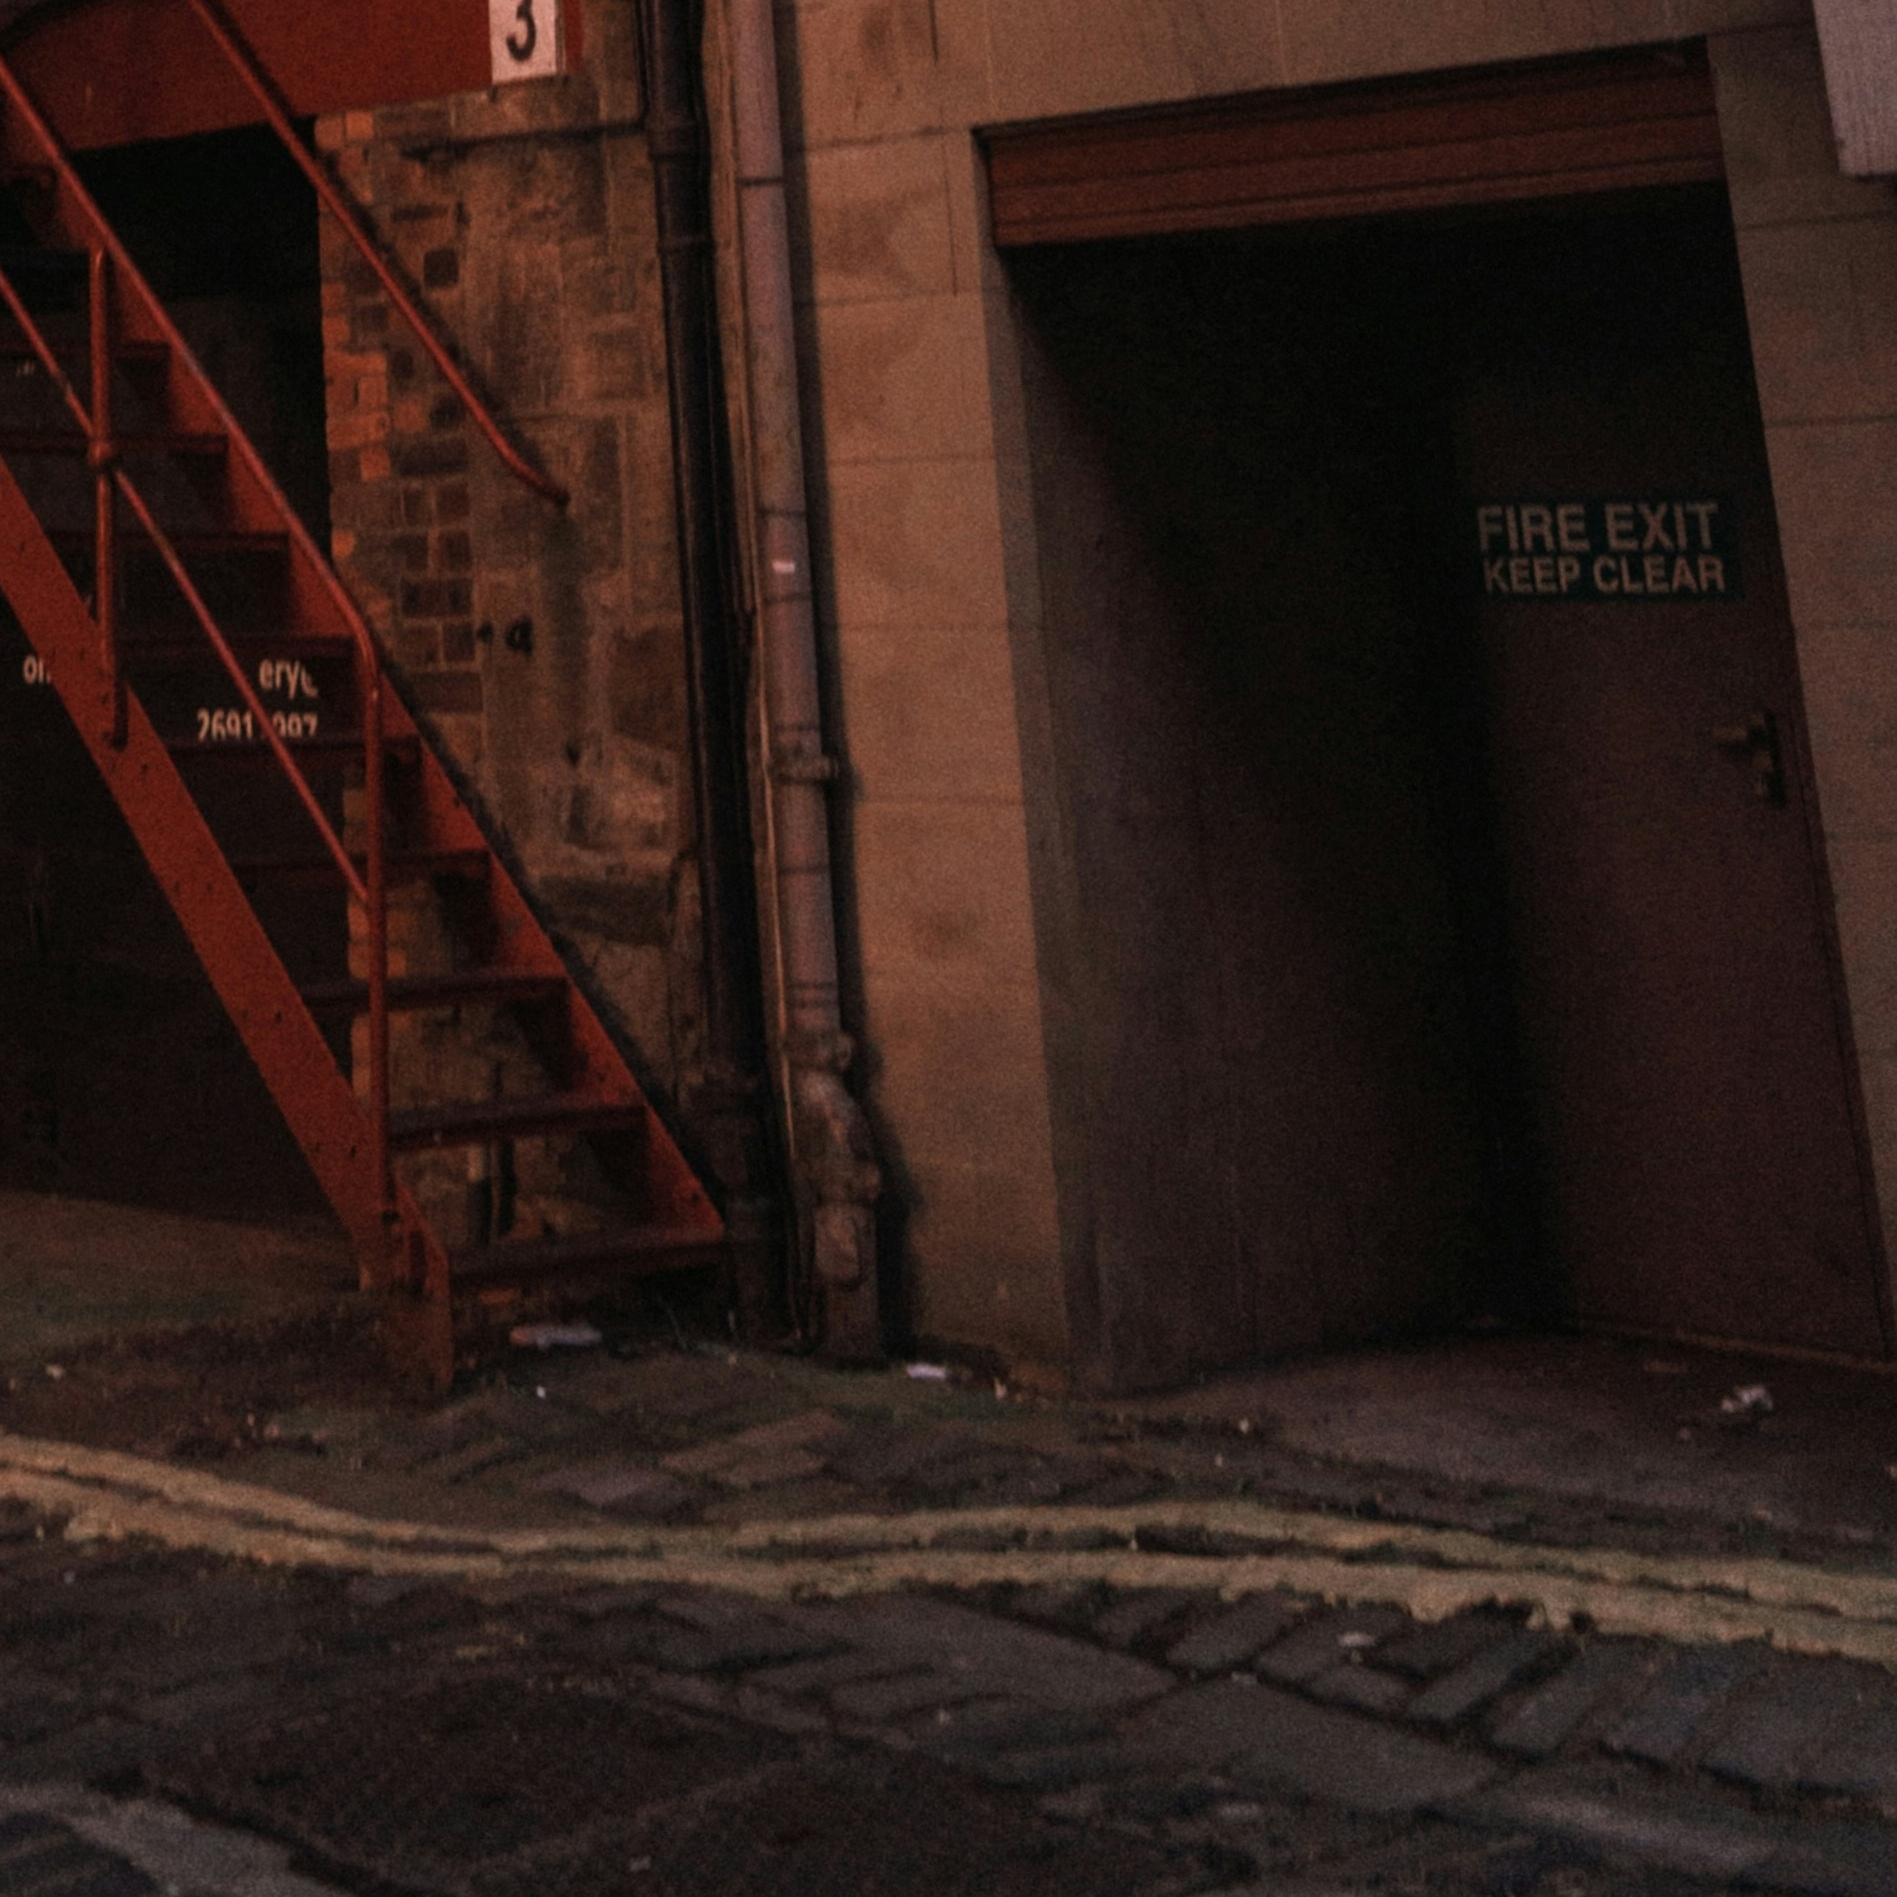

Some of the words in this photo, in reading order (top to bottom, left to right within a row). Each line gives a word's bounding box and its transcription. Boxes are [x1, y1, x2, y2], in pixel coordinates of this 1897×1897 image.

[1476, 504, 1591, 553] FIRE
[1605, 502, 1719, 553] EXIT
[1483, 556, 1581, 594] KEEP
[1593, 554, 1726, 594] CLEAR
